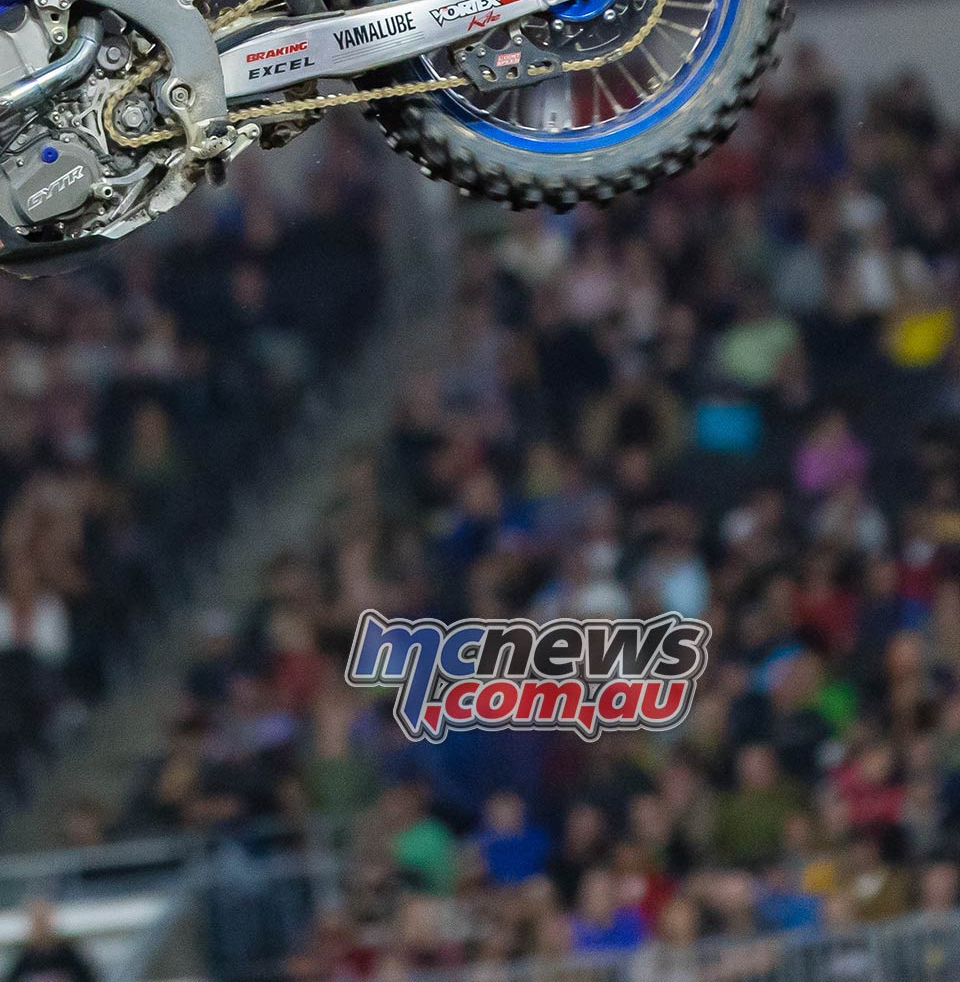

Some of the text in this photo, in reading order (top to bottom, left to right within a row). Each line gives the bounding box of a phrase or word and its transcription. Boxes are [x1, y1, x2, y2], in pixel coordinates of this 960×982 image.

[332, 12, 418, 51] YAMALUBE
[245, 40, 309, 63] BRAKING
[247, 56, 316, 81] EXCEL
